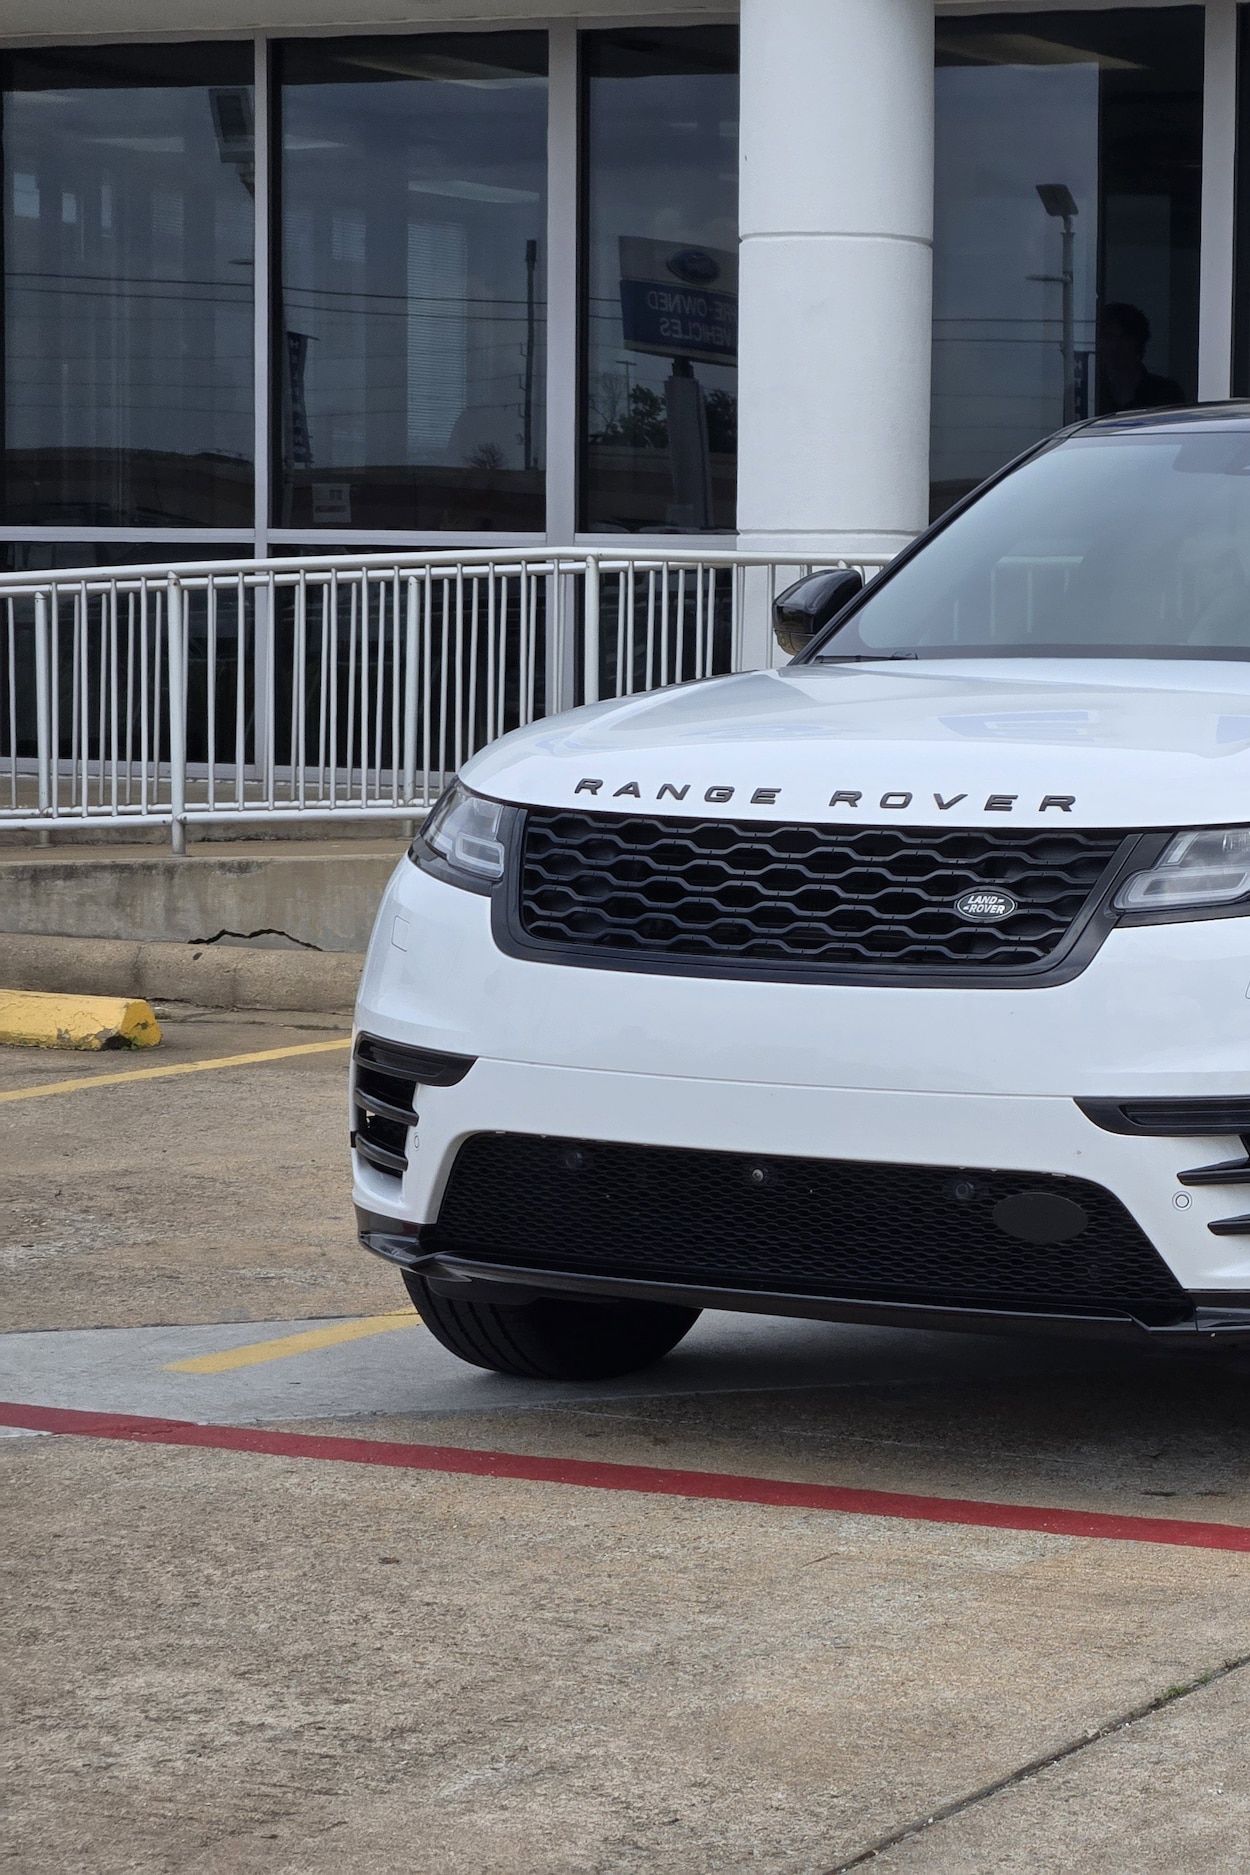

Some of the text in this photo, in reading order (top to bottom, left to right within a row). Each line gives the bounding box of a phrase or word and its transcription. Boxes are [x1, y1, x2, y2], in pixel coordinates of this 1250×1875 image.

[574, 777, 1076, 813] RANGE ROVER
[968, 896, 998, 904] LAND
[968, 904, 1005, 914] ROVER
